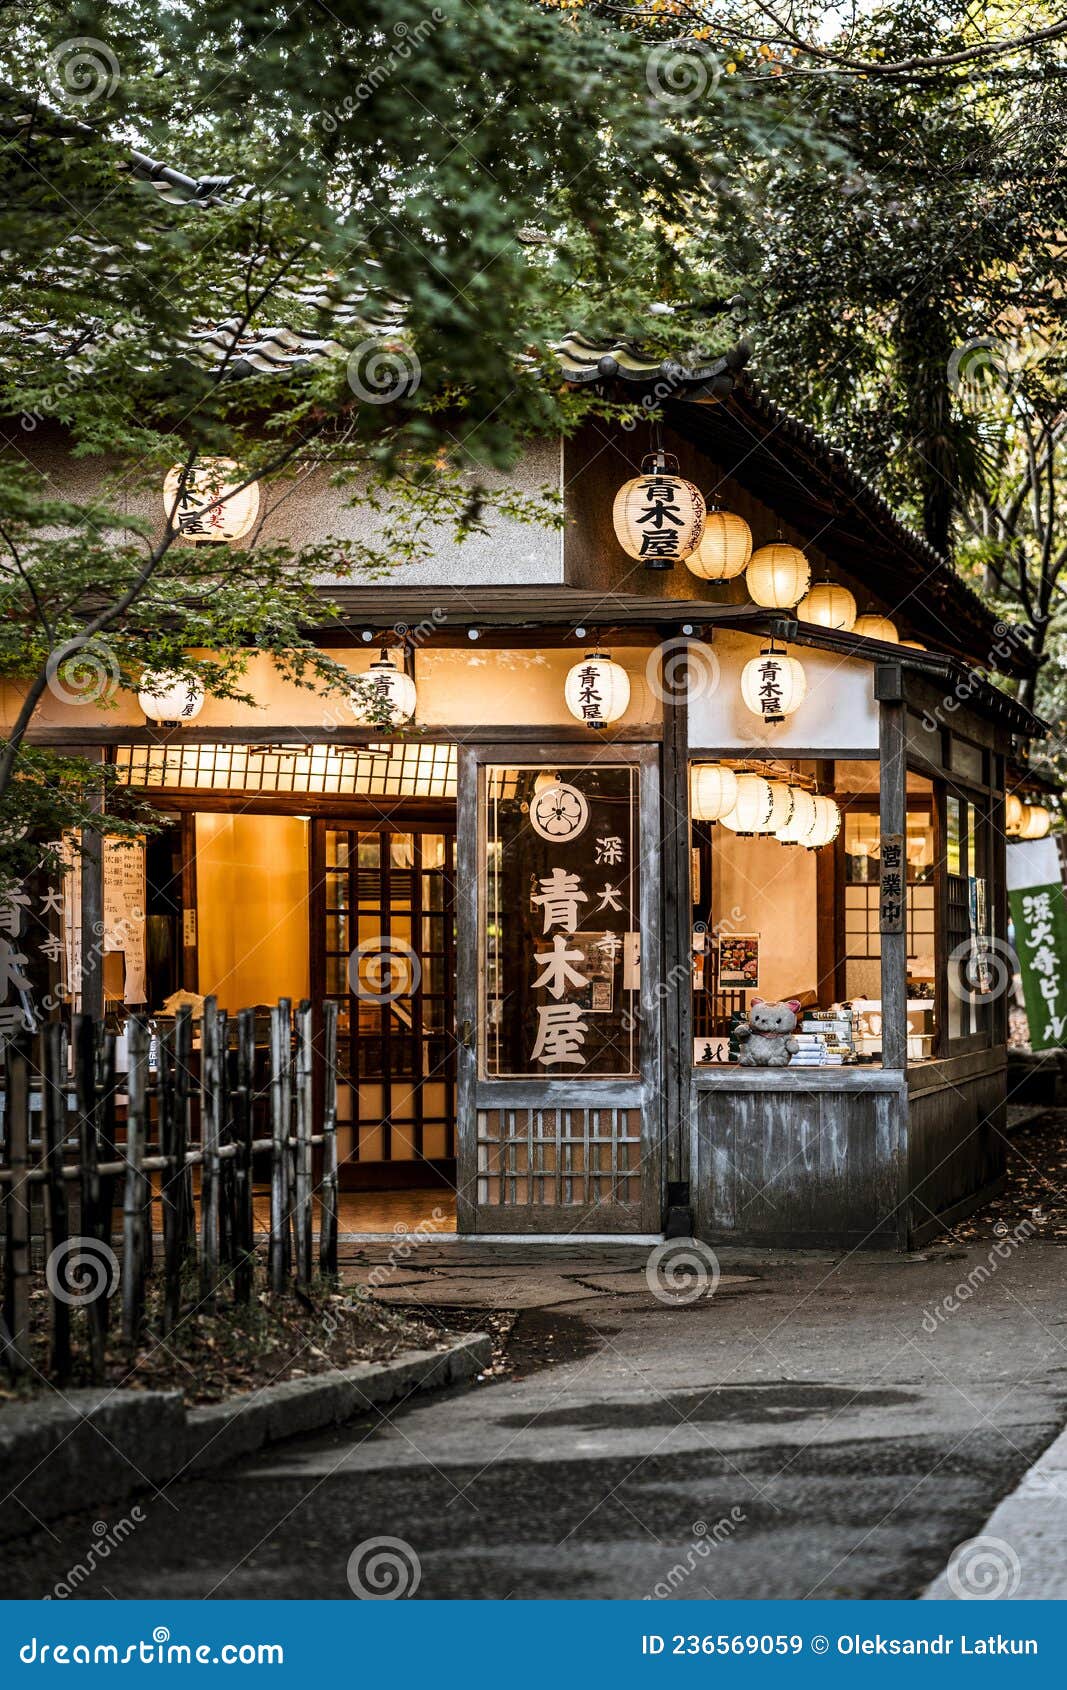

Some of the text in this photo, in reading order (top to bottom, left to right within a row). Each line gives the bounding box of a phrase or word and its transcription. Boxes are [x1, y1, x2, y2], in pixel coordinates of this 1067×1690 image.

[635, 477, 685, 558] 青木屋
[578, 665, 602, 719] 青木屋
[757, 661, 783, 713] 青木屋
[594, 836, 623, 959] 深大寺
[882, 844, 901, 924] 営業中
[530, 867, 590, 1066] 青木屋
[1022, 892, 1067, 1041] 深大寺ビール
